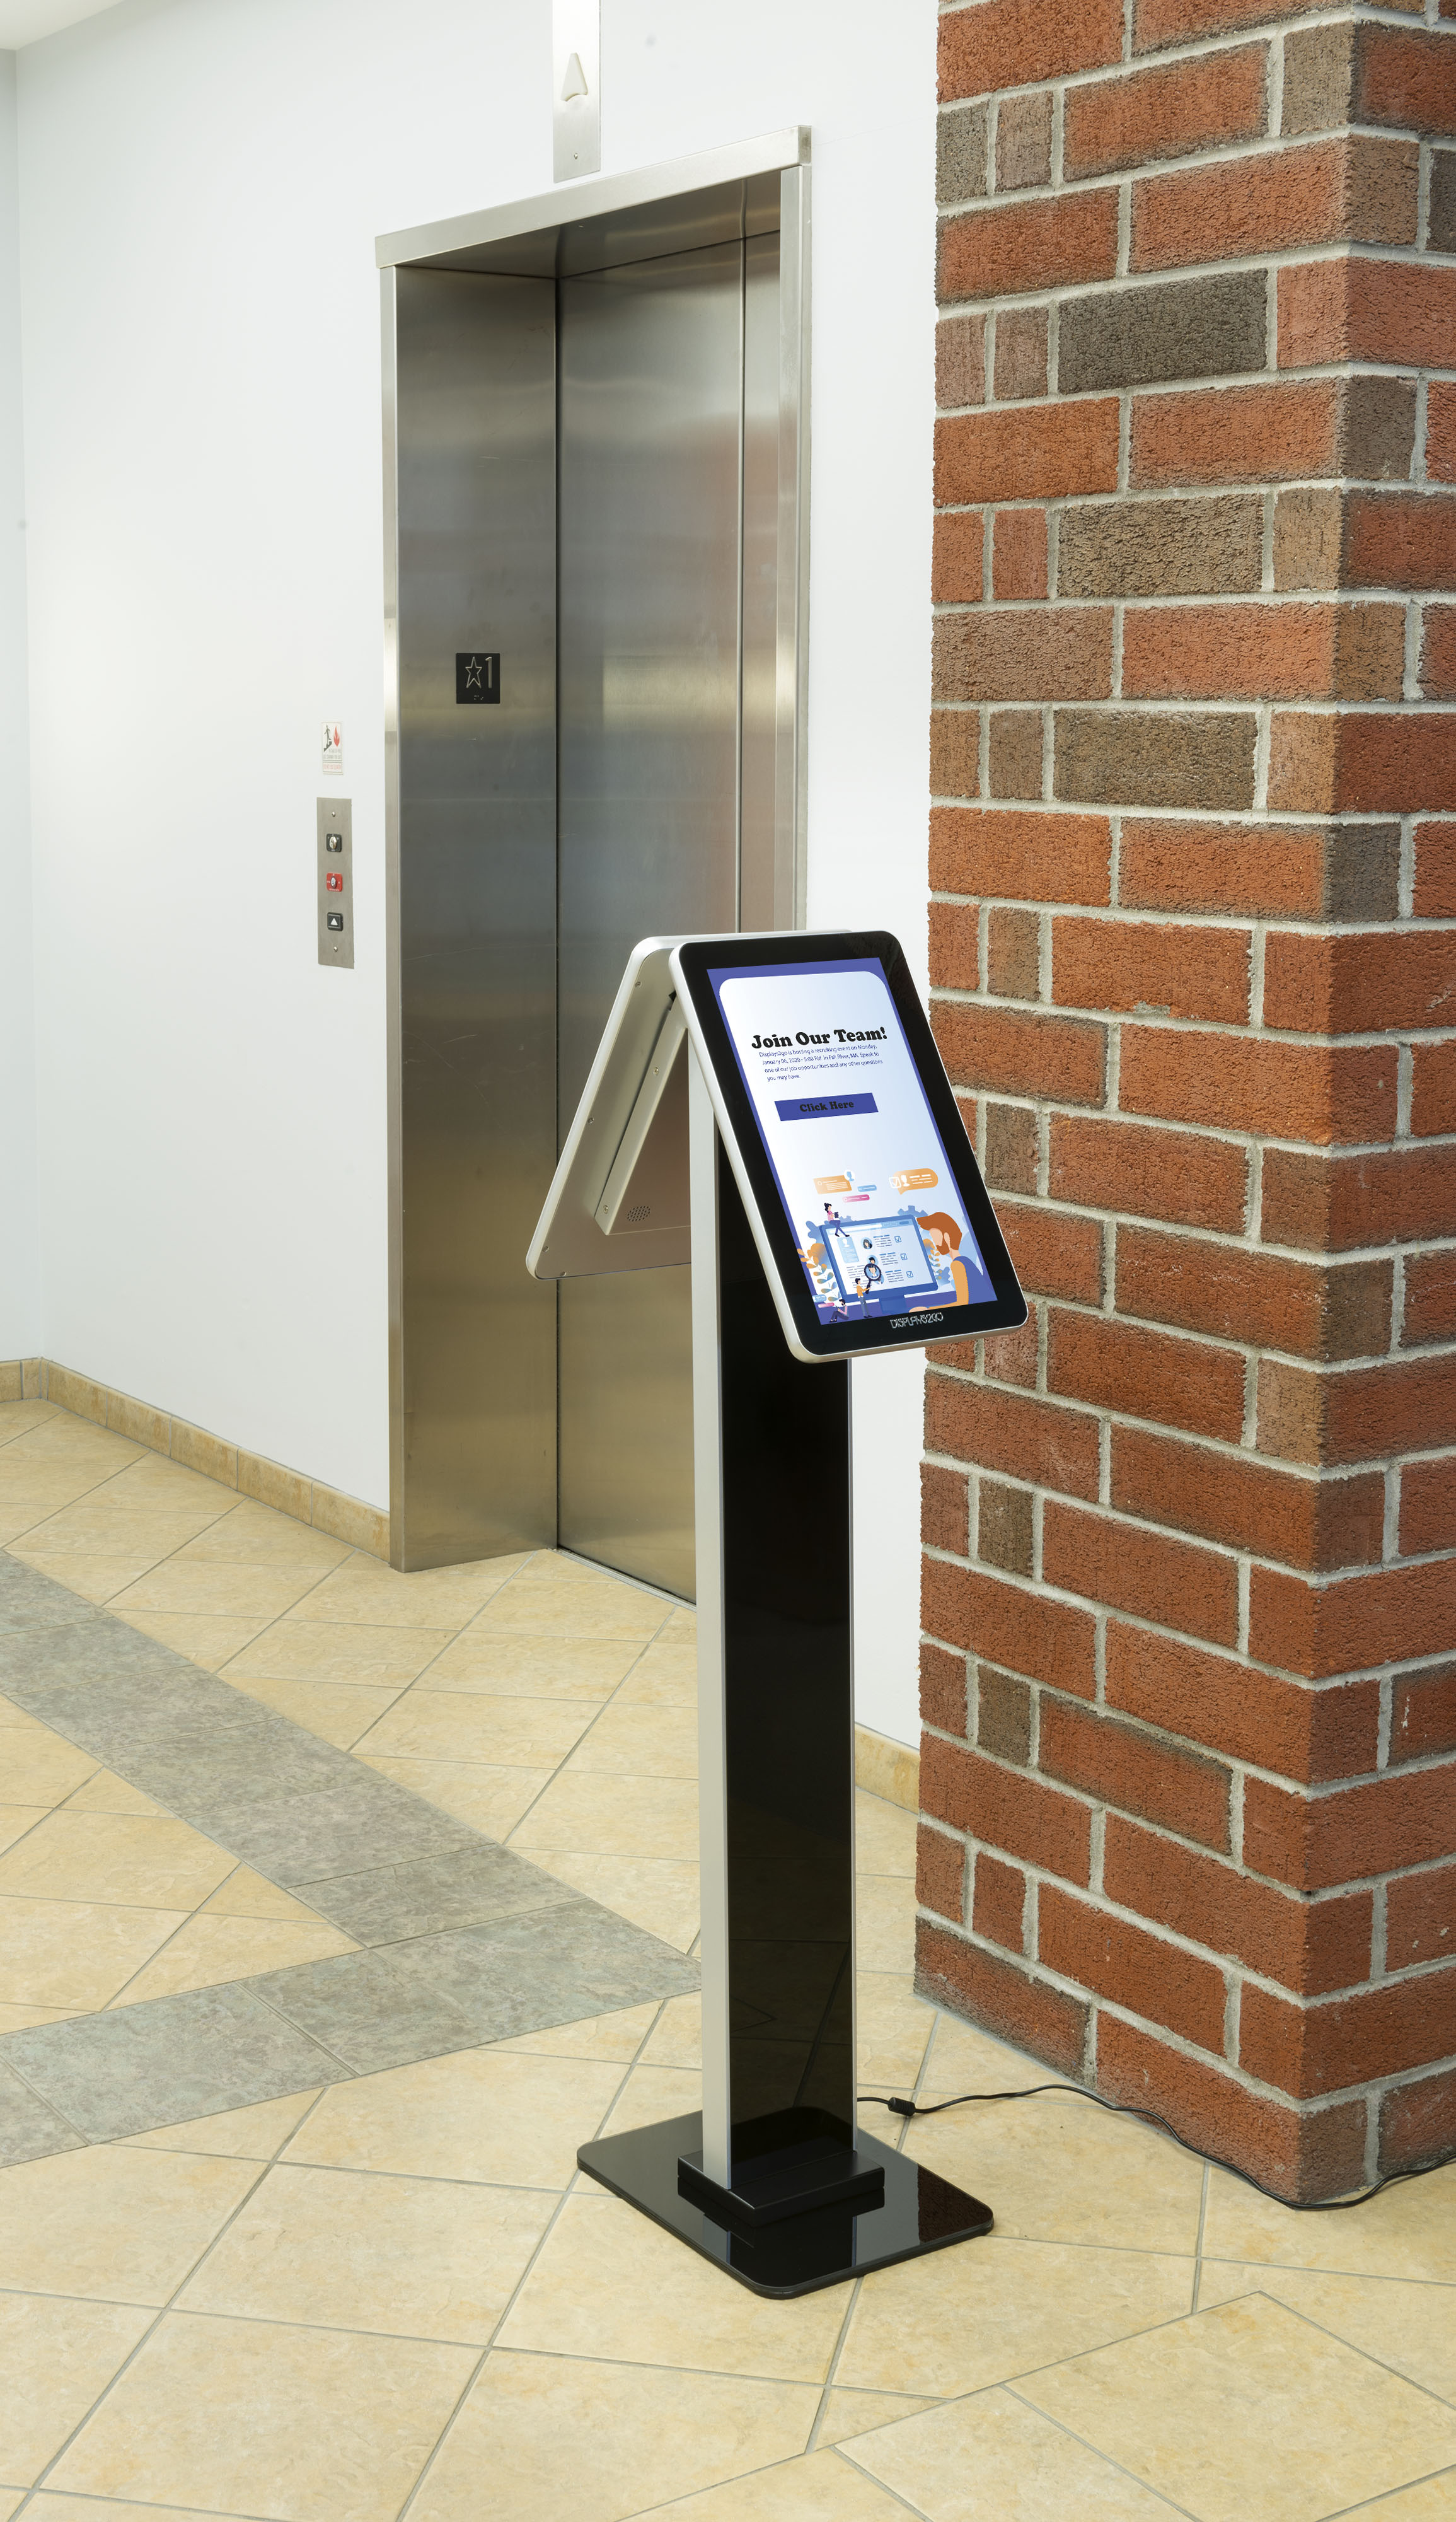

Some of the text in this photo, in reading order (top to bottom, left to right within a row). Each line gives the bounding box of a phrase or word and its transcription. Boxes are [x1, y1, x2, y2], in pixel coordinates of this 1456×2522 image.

[751, 1026, 887, 1049] Join Our Team!
[797, 1063, 829, 1071] opportunities
[799, 1101, 854, 1112] Click Here
[889, 1312, 944, 1329] DISPLAYS2GO
